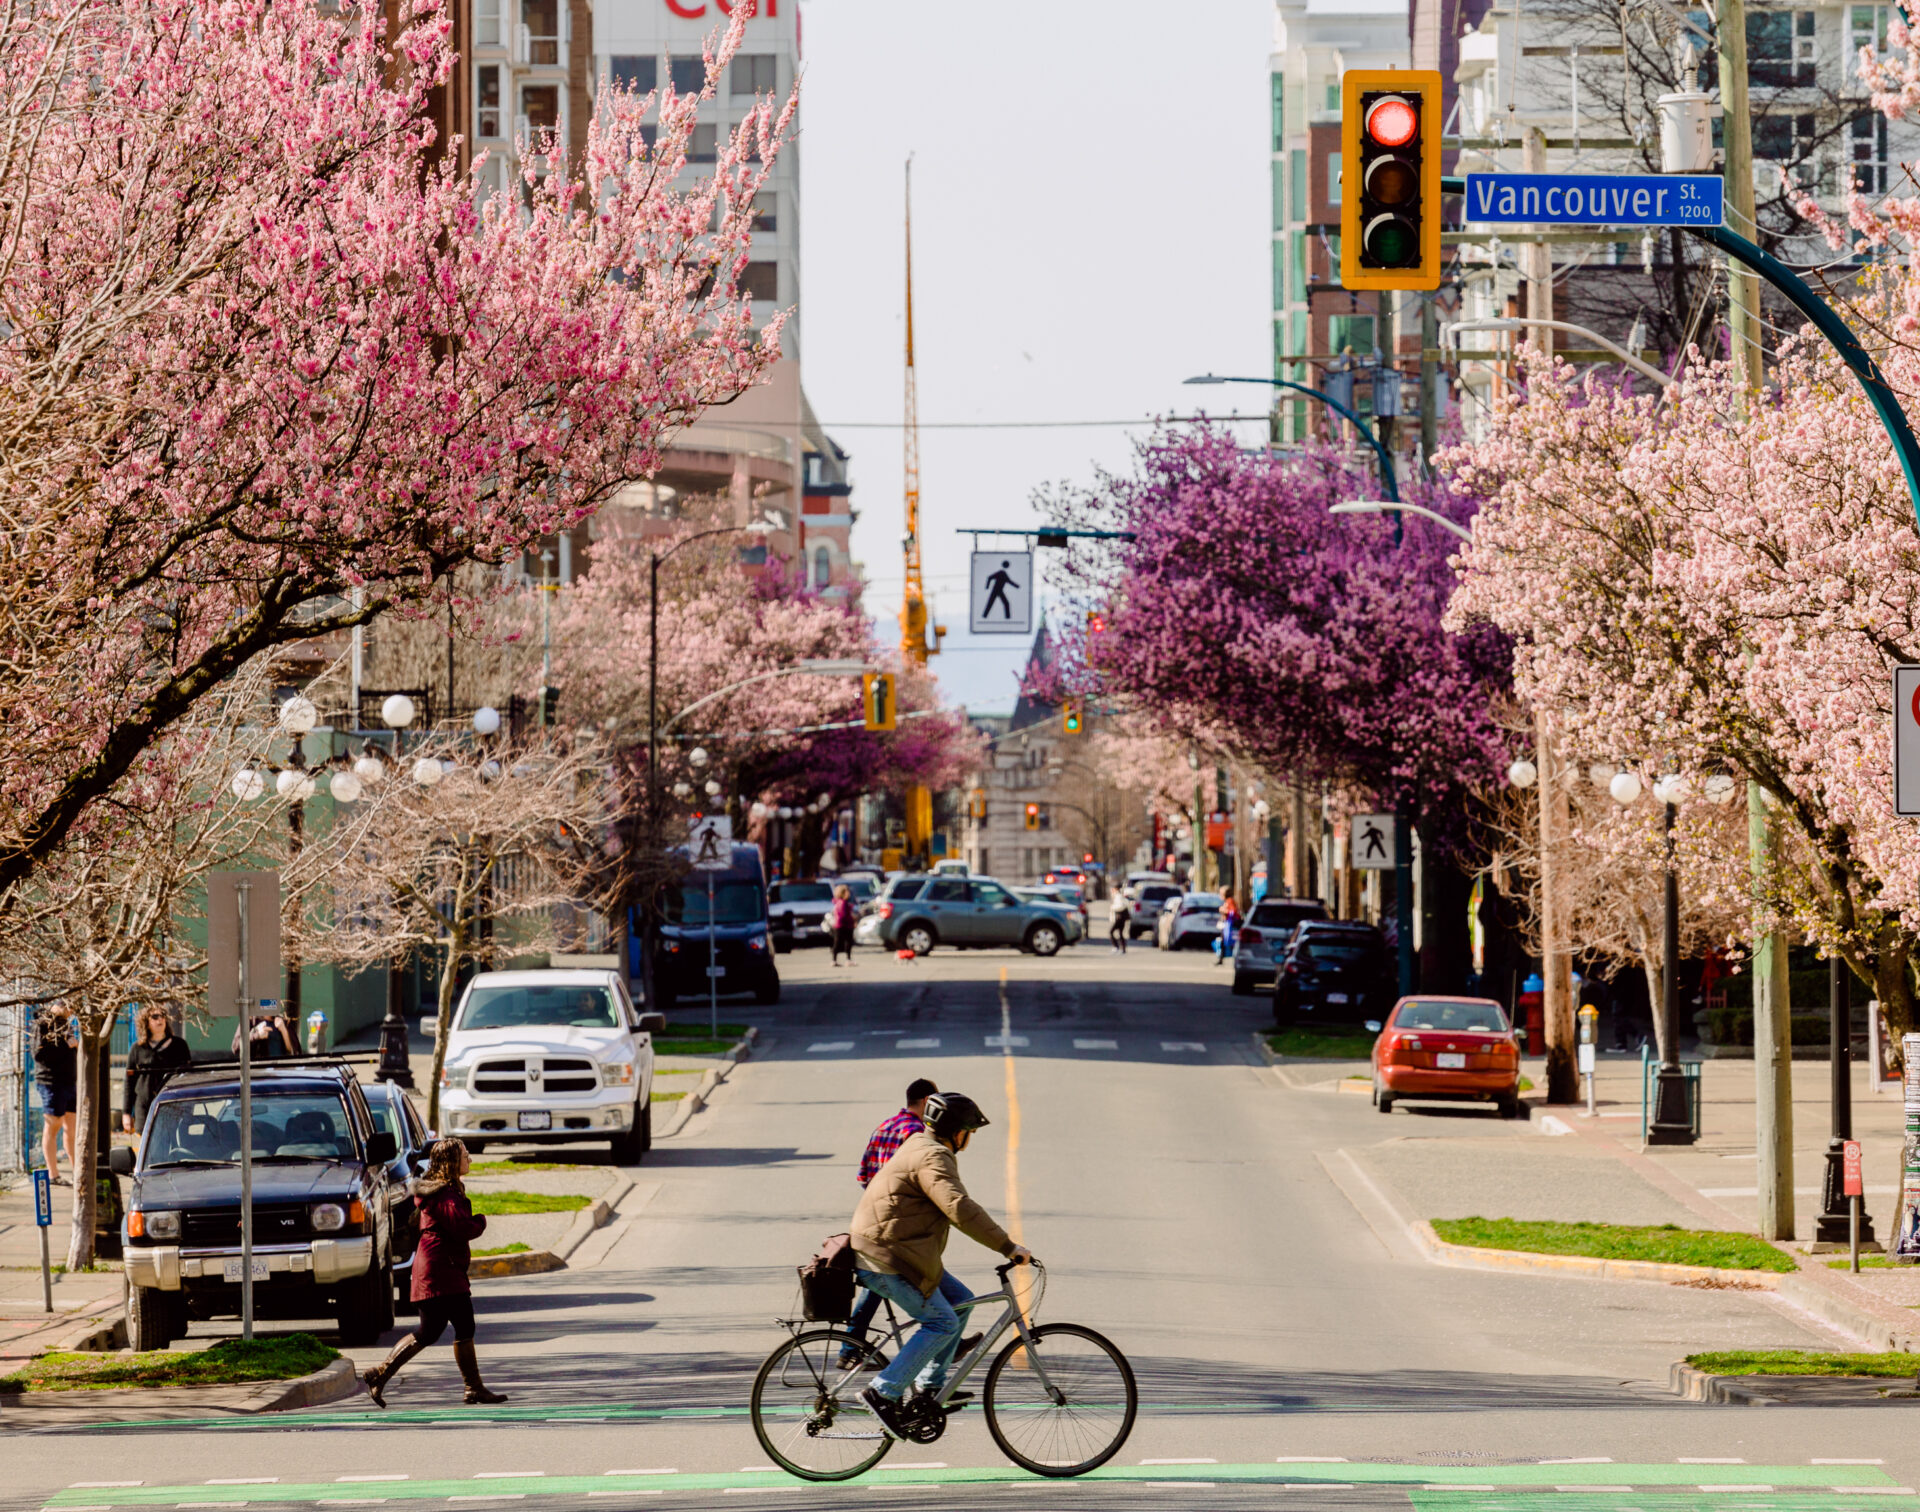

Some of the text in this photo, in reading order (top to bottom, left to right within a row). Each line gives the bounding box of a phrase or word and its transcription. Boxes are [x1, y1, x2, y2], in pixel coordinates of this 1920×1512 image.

[1476, 180, 1701, 217] Vancouver St.
[1679, 205, 1711, 218] 1200
